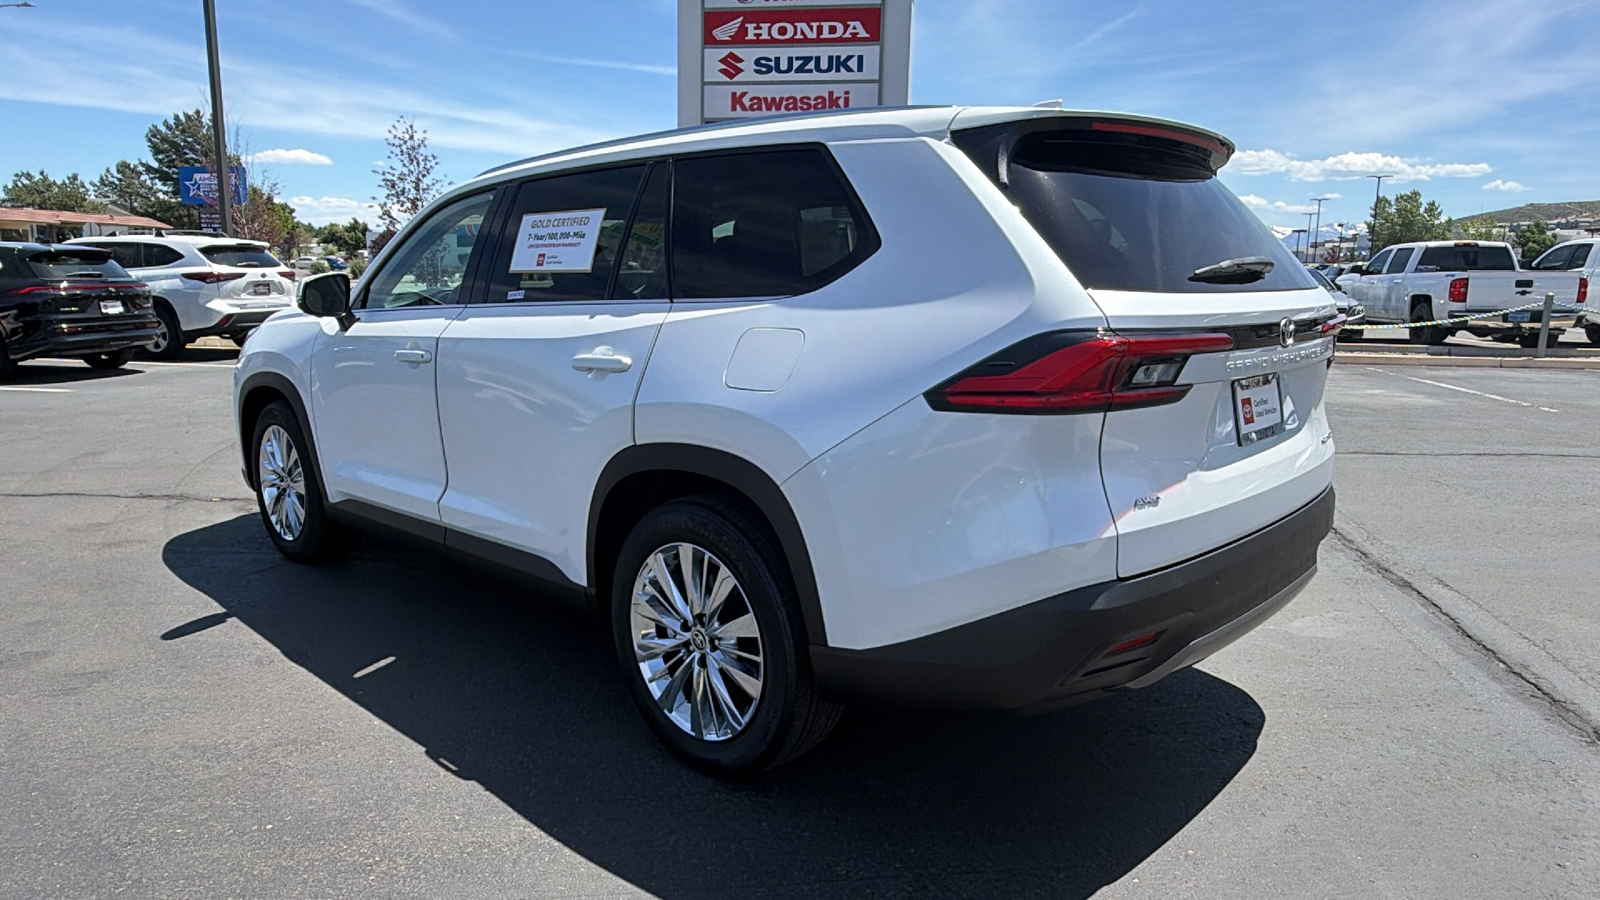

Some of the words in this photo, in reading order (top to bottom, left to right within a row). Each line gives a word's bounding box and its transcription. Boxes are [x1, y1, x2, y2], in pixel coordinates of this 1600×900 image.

[745, 20, 870, 40] HONDA
[753, 54, 864, 76] SUZUKI
[730, 90, 850, 112] Kawasaki
[531, 219, 551, 229] GOLD
[552, 216, 590, 228] CERTIFIED
[527, 230, 586, 242] 7-Year/100,000-Mile
[1253, 397, 1269, 408] Certified
